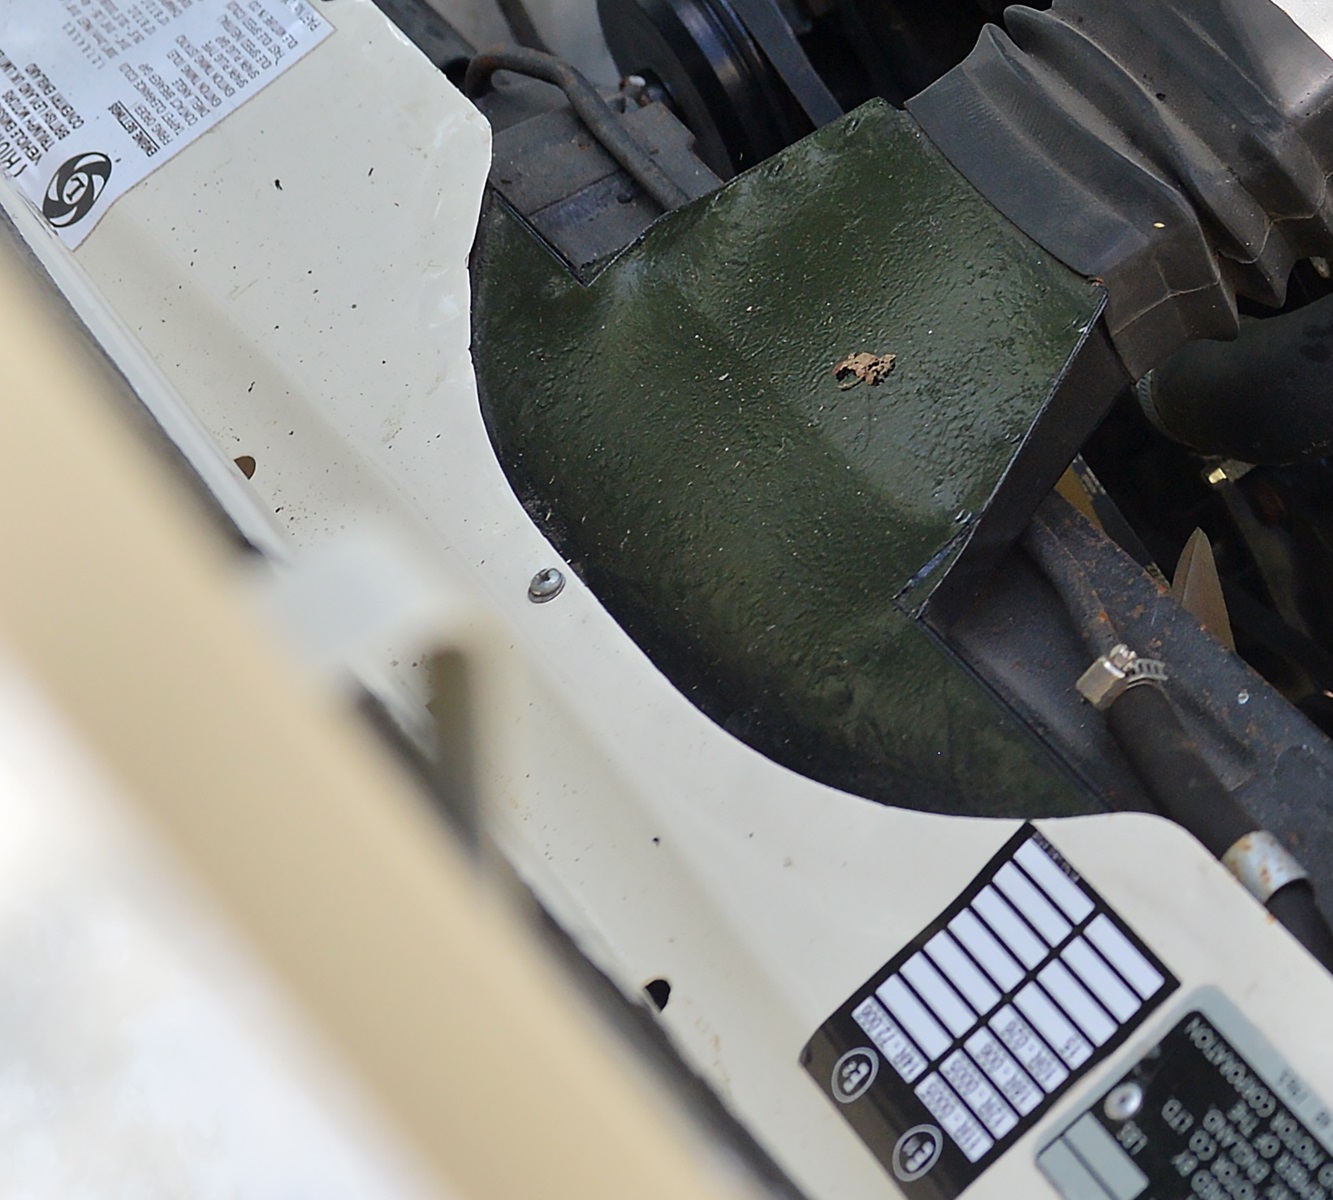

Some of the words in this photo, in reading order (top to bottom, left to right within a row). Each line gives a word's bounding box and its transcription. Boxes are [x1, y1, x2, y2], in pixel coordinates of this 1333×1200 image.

[241, 15, 262, 36] SPEED
[224, 43, 244, 63] PLUG
[240, 37, 261, 59] SPEED
[281, 33, 298, 49] IDLE
[212, 51, 232, 71] PLUG
[239, 58, 259, 79] SPARK
[255, 53, 272, 70] IDLE
[22, 61, 57, 97] ENGLAND
[147, 71, 175, 101] BREAKER
[171, 76, 193, 99] ANGLE
[210, 71, 235, 98] IGNITION
[227, 67, 248, 89] SPARK
[0, 88, 31, 121] MOTORS
[16, 80, 49, 115] LEYLAND
[133, 78, 166, 115] CLEARANCE
[196, 80, 222, 108] IGNITION
[39, 108, 71, 141] BRITISH
[47, 90, 85, 131] COVENTRY
[106, 101, 138, 135] SETTINGS
[132, 102, 156, 127] ORDER
[160, 109, 185, 136] TAPPET
[169, 96, 198, 127] CONTACT
[8, 126, 46, 166] VEHICLE
[21, 114, 57, 152] TRIUMPH
[131, 129, 158, 158] ENGINE
[1179, 1013, 1281, 1121] CORPORATION
[1248, 1126, 1284, 1162] OF
[1266, 1107, 1328, 1172] MOTOR
